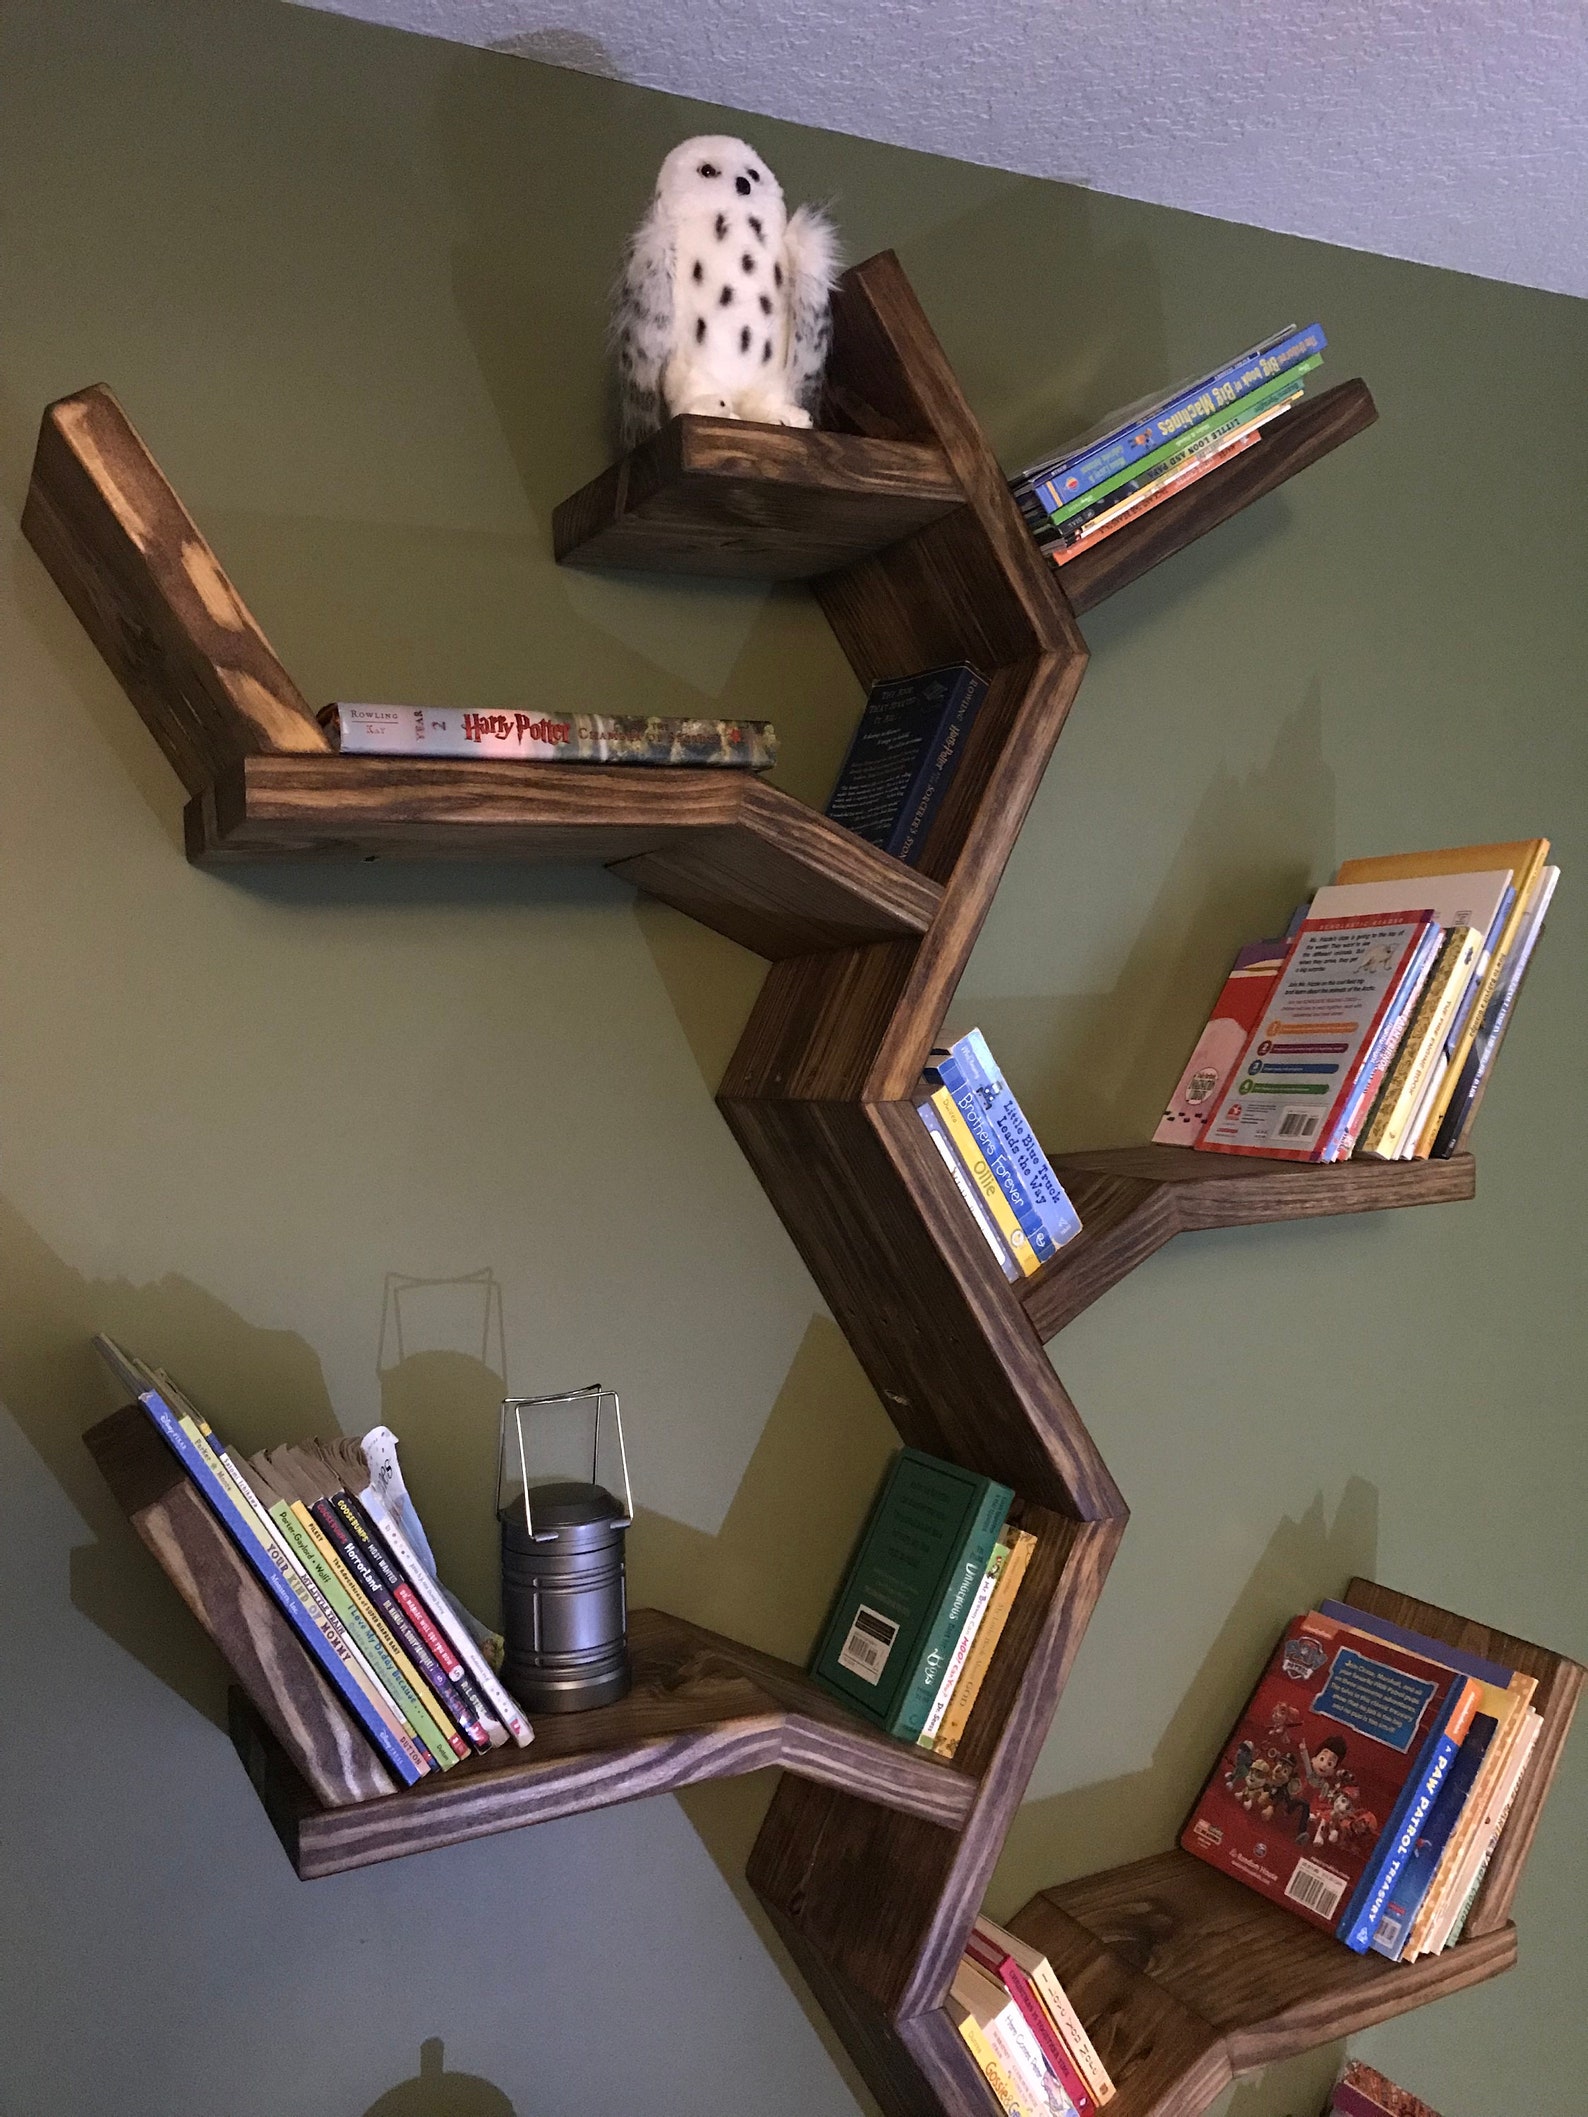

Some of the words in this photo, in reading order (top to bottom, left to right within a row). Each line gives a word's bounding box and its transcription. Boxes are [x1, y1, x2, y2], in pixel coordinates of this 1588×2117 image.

[1241, 366, 1262, 386] book
[1258, 356, 1279, 378] Big
[1211, 382, 1237, 407] Big
[1158, 394, 1216, 434] Machines
[1211, 418, 1240, 439] LITTLE
[1169, 451, 1185, 465] AND
[1187, 436, 1209, 454] LOON
[1146, 462, 1168, 478] PAPA
[1067, 516, 1083, 527] DIAL
[956, 679, 977, 721] ROWLING
[350, 709, 398, 720] ROWLING
[414, 710, 424, 741] YEAR
[462, 712, 515, 743] Harry
[514, 712, 571, 746] Potter
[943, 724, 959, 747] Harry
[935, 746, 953, 770] Potter
[898, 835, 913, 858] STON
[1493, 968, 1500, 977] to
[1480, 976, 1497, 1002] Babysit
[1442, 1000, 1451, 1015] THE
[1433, 1017, 1444, 1036] FIRE
[1465, 1008, 1480, 1036] Grandpa
[1375, 1035, 1397, 1071] FRIENDS
[1420, 1037, 1435, 1068] ENGINE
[1409, 1069, 1421, 1095] BOOK
[958, 1092, 995, 1154] Brothers
[991, 1154, 1023, 1205] Forever
[996, 1115, 1019, 1154] Leads
[1017, 1154, 1031, 1175] the
[1029, 1176, 1046, 1204] Way
[1003, 1100, 1023, 1134] Little
[1021, 1133, 1039, 1164] Blue
[1037, 1164, 1060, 1203] Truck
[973, 1160, 995, 1196] Ollie
[172, 1432, 186, 1449] PIXAR
[194, 1438, 211, 1460] Parker
[308, 1522, 323, 1541] PILKEY
[337, 1500, 368, 1541] GOOSEBUMPS
[367, 1543, 382, 1560] MOST
[378, 1559, 397, 1583] WANTED
[279, 1511, 314, 1559] Porter-Gaylord
[315, 1563, 331, 1582] Wolff
[317, 1503, 347, 1543] GOOSEBUMPS
[344, 1542, 381, 1590] HorrorLand
[267, 1543, 288, 1573] YOUR
[287, 1574, 310, 1601] KIND
[309, 1604, 322, 1619] OF
[321, 1622, 350, 1660] MOMMY
[299, 1573, 312, 1587] MY
[308, 1584, 330, 1613] LITTLE
[325, 1611, 346, 1635] TRAIN
[332, 1557, 341, 1569] The
[339, 1568, 362, 1600] Adventures
[360, 1599, 368, 1607] of
[365, 1606, 378, 1622] SUPER
[376, 1622, 391, 1641] DIAPER
[388, 1640, 400, 1654] BABY
[971, 1594, 986, 1618] Brown
[350, 1608, 365, 1629] Love
[364, 1630, 376, 1642] My
[374, 1642, 396, 1669] Daddy
[406, 1599, 422, 1619] MANIAC
[442, 1654, 452, 1665] NOW
[956, 1636, 969, 1663] MOO!
[921, 1648, 944, 1684] Boys
[936, 1701, 944, 1712] Dr.
[959, 1681, 973, 1706] GOD
[927, 1713, 940, 1731] Seuss
[399, 1736, 421, 1764] DUTTON
[1426, 1755, 1447, 1794] PAW
[1397, 1796, 1429, 1853] PATROL
[1369, 1861, 1399, 1921] TREASURY
[1009, 1970, 1033, 2011] CHRISTMAS
[1031, 2010, 1038, 2020] IS
[1036, 2019, 1059, 2059] TOGETHER
[1057, 2058, 1069, 2077] TIME
[984, 2061, 1008, 2099] Gossie
[1002, 2094, 1013, 2107] &
